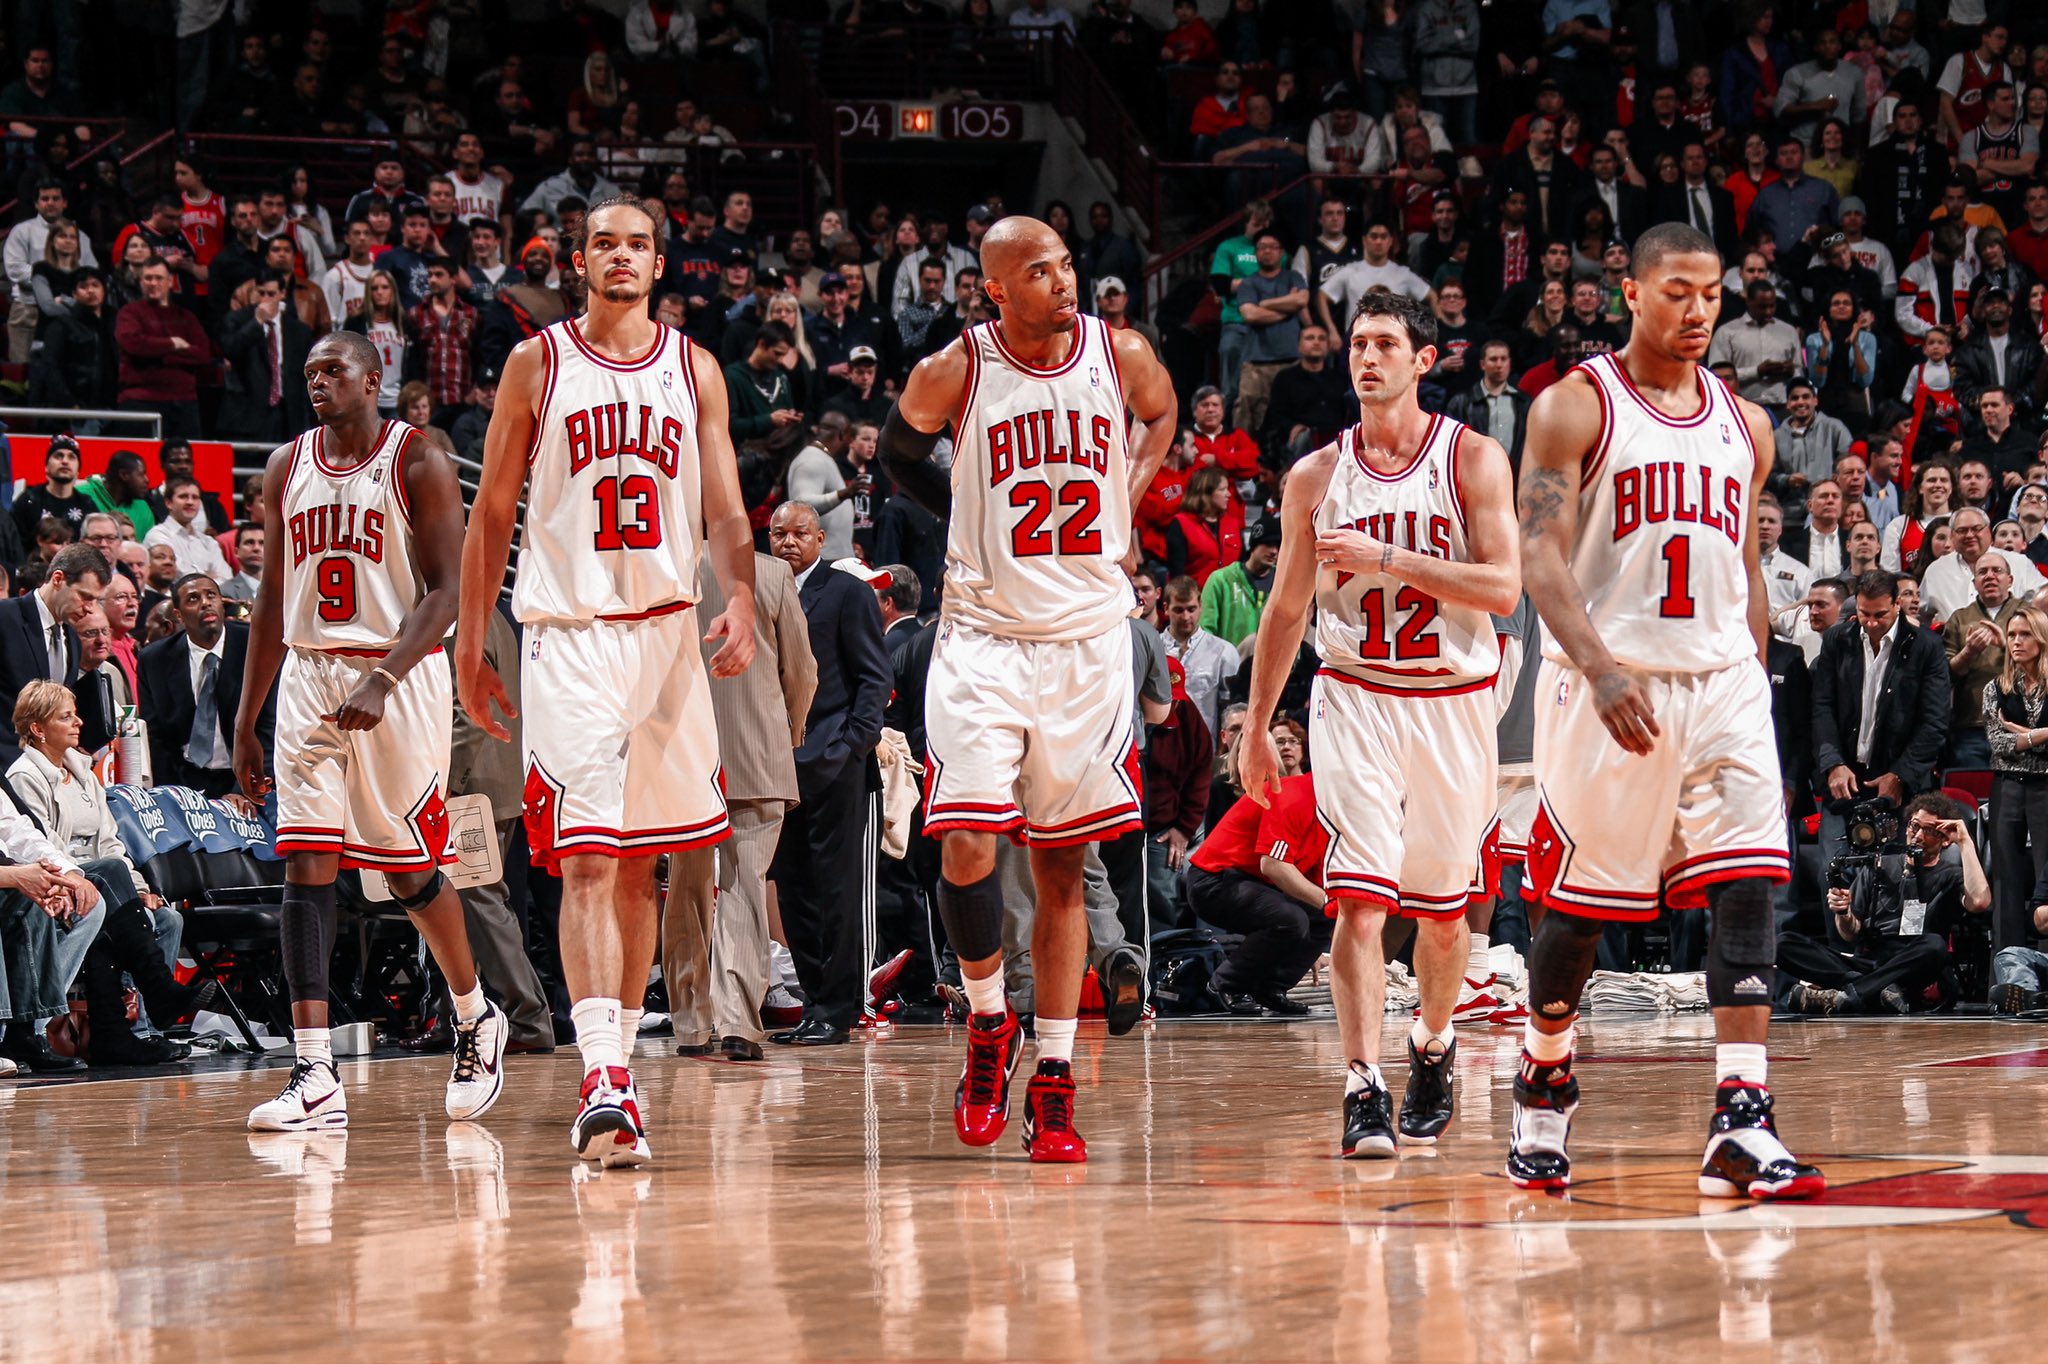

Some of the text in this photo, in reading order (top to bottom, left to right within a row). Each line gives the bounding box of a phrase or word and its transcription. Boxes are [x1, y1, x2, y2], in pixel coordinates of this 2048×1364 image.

[902, 110, 933, 132] EXIT
[952, 106, 1010, 137] 105
[195, 224, 205, 246] 1
[383, 345, 392, 366] 1
[566, 401, 684, 480] BULLS
[987, 409, 1111, 489] BULLS
[289, 503, 385, 572] BULLS
[592, 474, 663, 552] 13
[1008, 480, 1102, 558] 22
[1613, 461, 1741, 548] BULLS
[316, 556, 357, 622] 9
[1336, 511, 1450, 591] LLS
[1659, 534, 1695, 618] 1
[1359, 586, 1440, 661] 12
